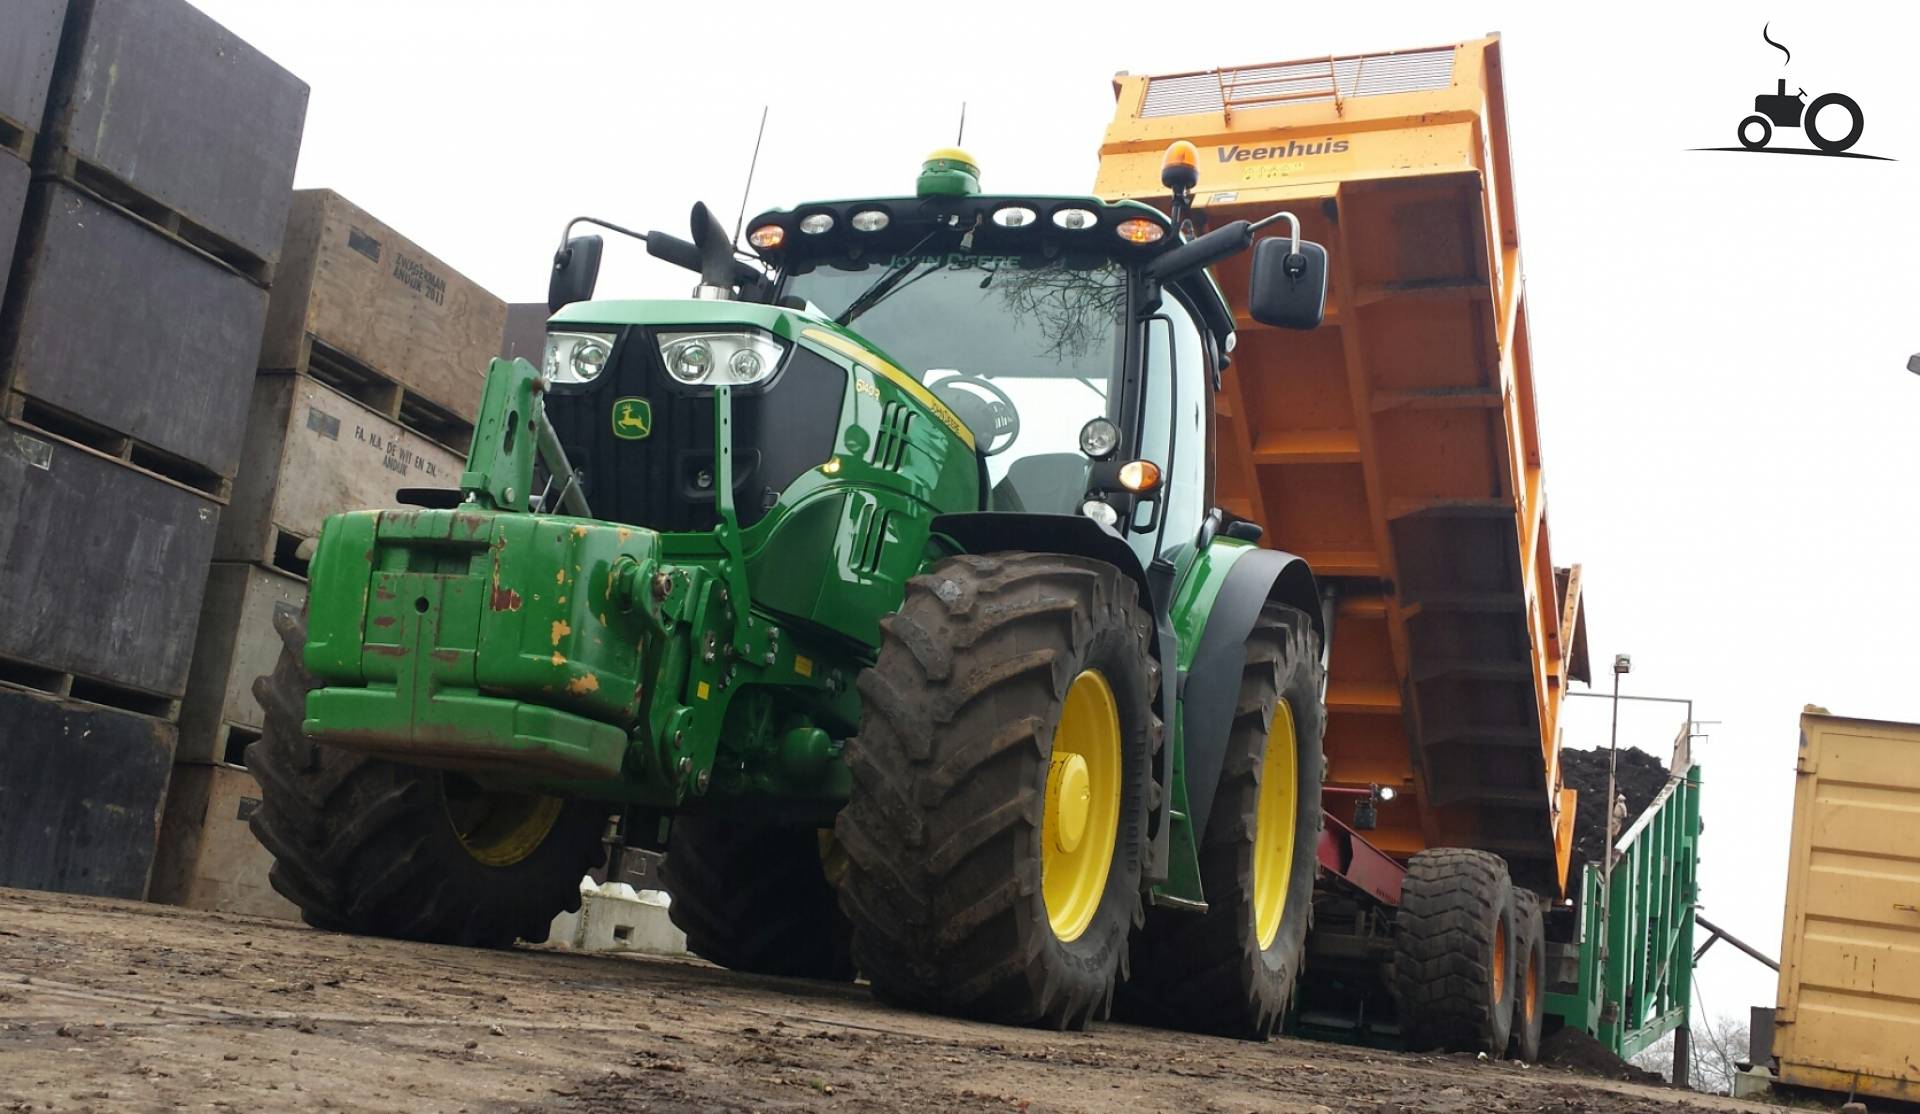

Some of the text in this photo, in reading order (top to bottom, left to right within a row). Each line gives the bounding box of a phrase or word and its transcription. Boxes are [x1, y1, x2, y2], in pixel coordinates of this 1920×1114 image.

[1217, 138, 1349, 163] Veenhuis
[386, 442, 397, 457] DE
[415, 455, 425, 472] EN
